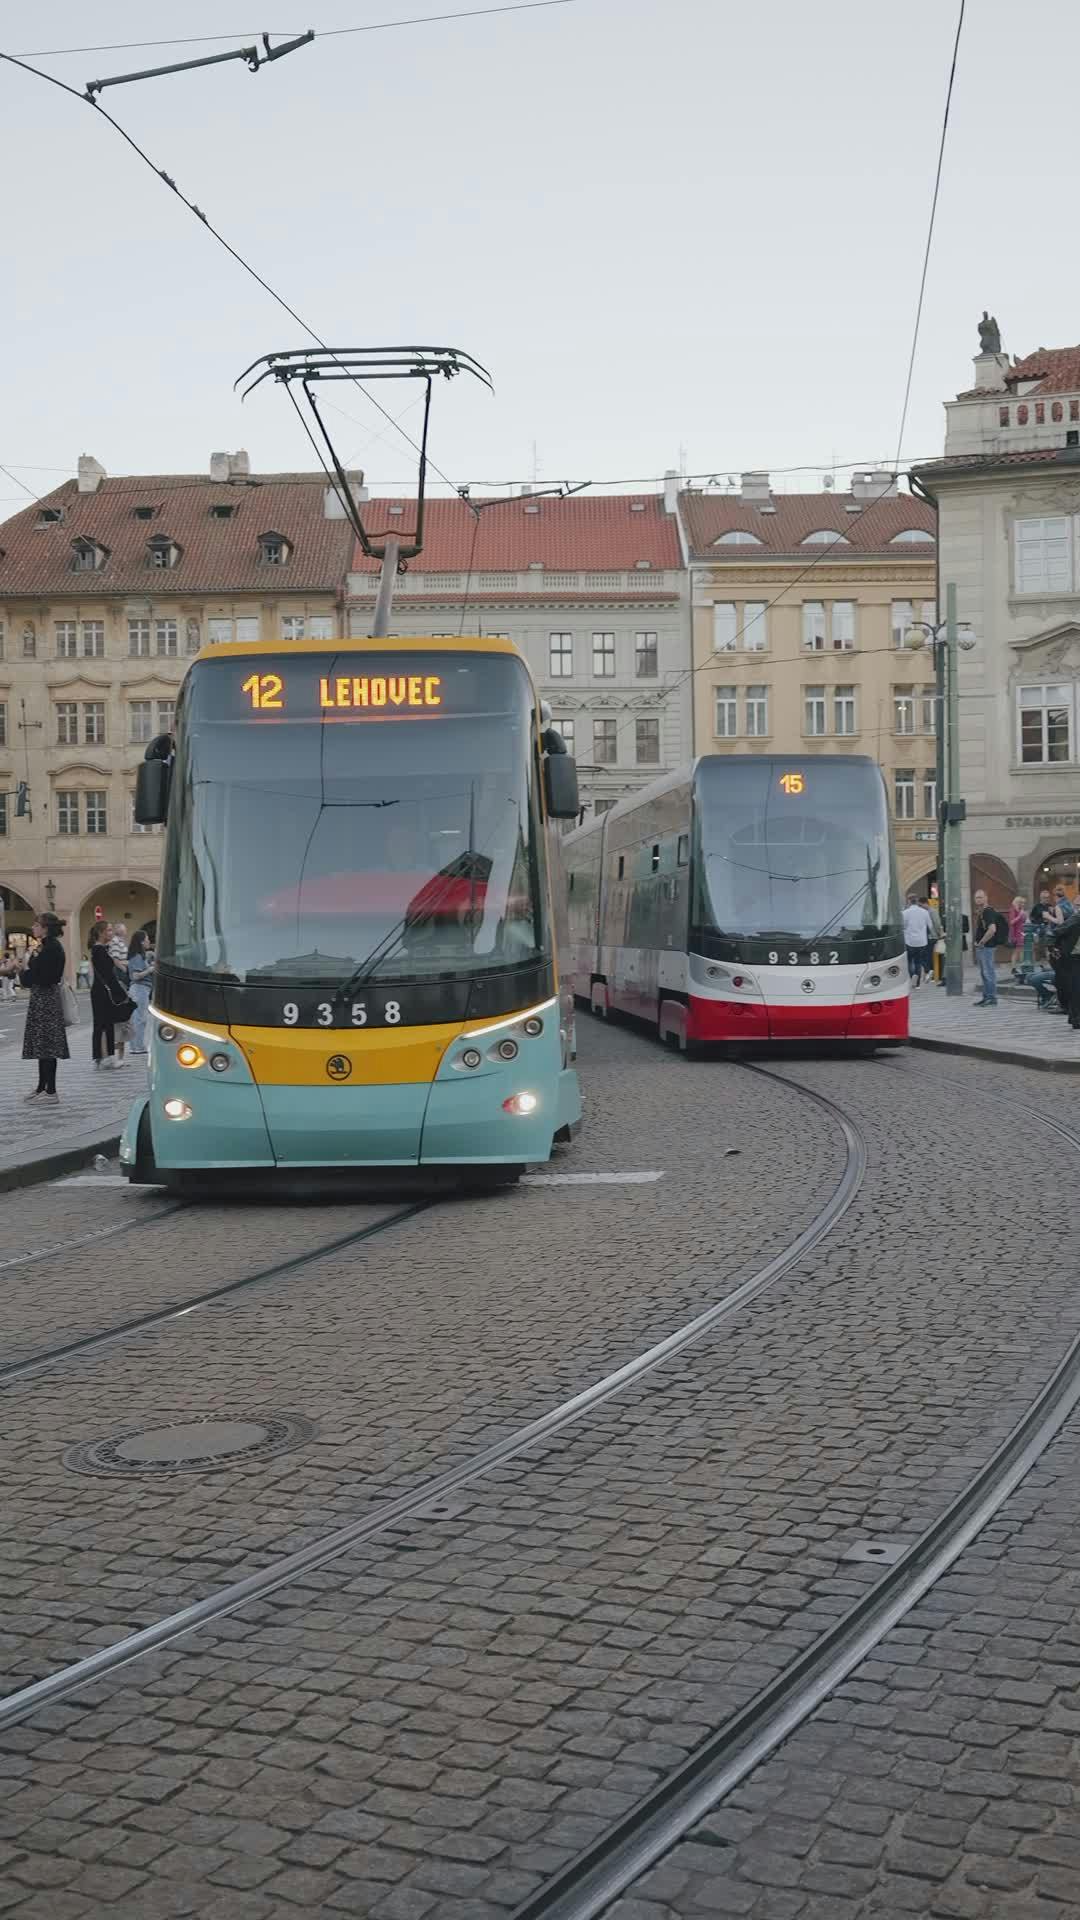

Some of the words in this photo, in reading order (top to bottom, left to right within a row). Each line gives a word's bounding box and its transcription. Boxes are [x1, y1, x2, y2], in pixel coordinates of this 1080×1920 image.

[242, 674, 283, 708] 12
[319, 676, 441, 707] LEHOVEC
[779, 773, 803, 794] 15
[768, 951, 839, 965] 9382
[283, 1000, 401, 1026] 9358
